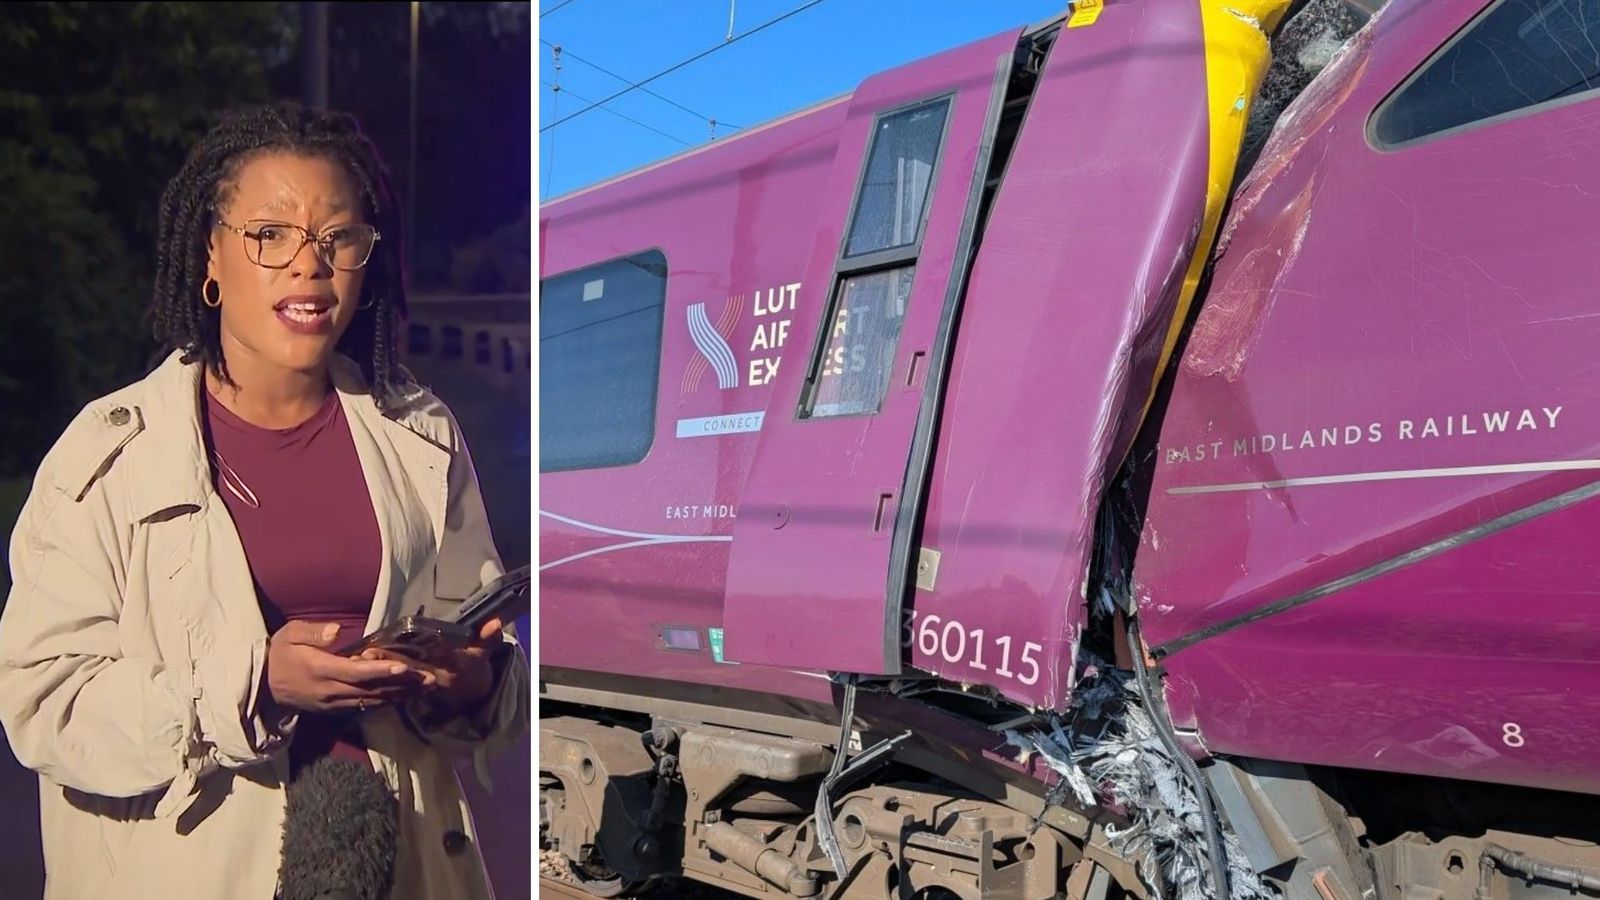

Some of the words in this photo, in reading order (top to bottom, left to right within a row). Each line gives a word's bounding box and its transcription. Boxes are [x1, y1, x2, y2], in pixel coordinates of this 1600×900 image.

[703, 416, 760, 432] CONNECT
[1165, 441, 1223, 464] EAST
[1233, 423, 1382, 457] MIDLANDS
[1399, 406, 1563, 440] RAILWAY
[666, 505, 699, 519] EAST
[901, 608, 1042, 685] 360115
[1502, 722, 1525, 747] 8
